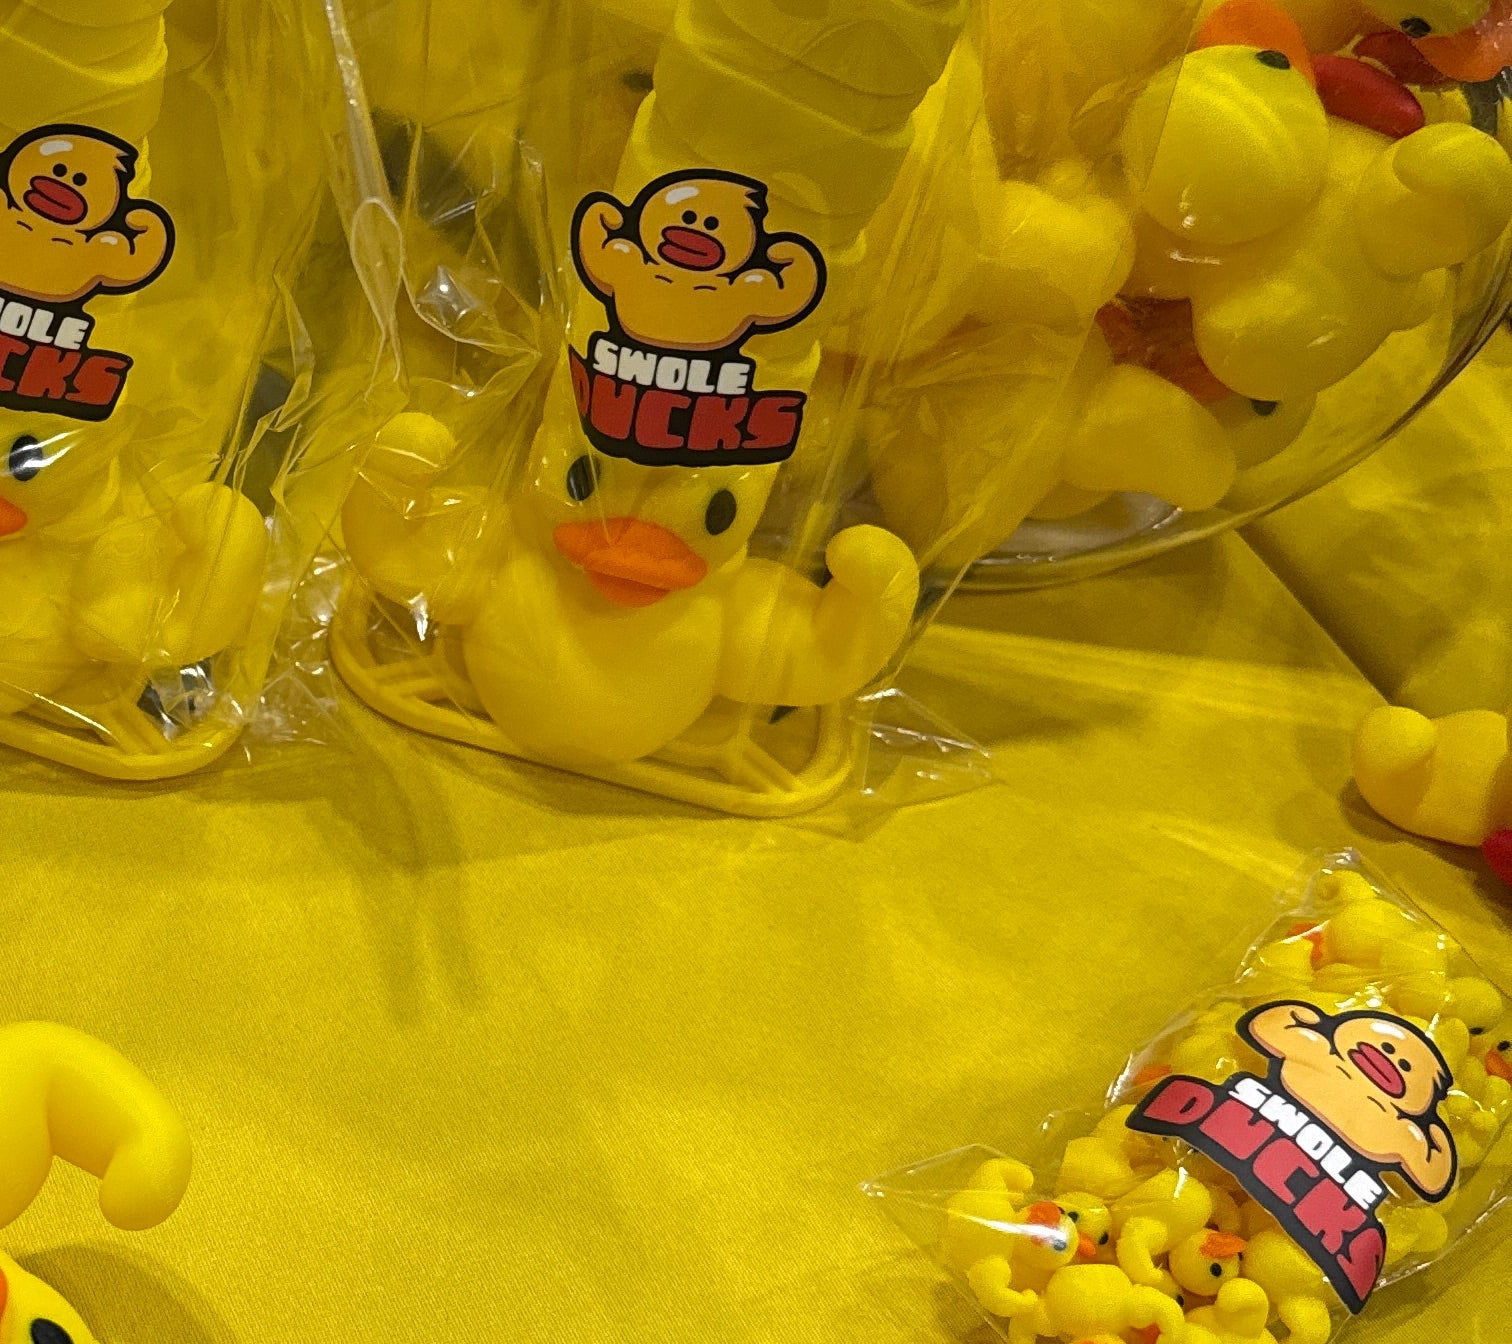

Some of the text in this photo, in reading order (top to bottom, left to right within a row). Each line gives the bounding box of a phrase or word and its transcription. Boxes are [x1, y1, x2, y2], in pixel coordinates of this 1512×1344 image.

[593, 338, 750, 395] SWOLE
[1143, 1079, 1384, 1301] DUCKS
[1228, 1078, 1383, 1210] SWOLE
